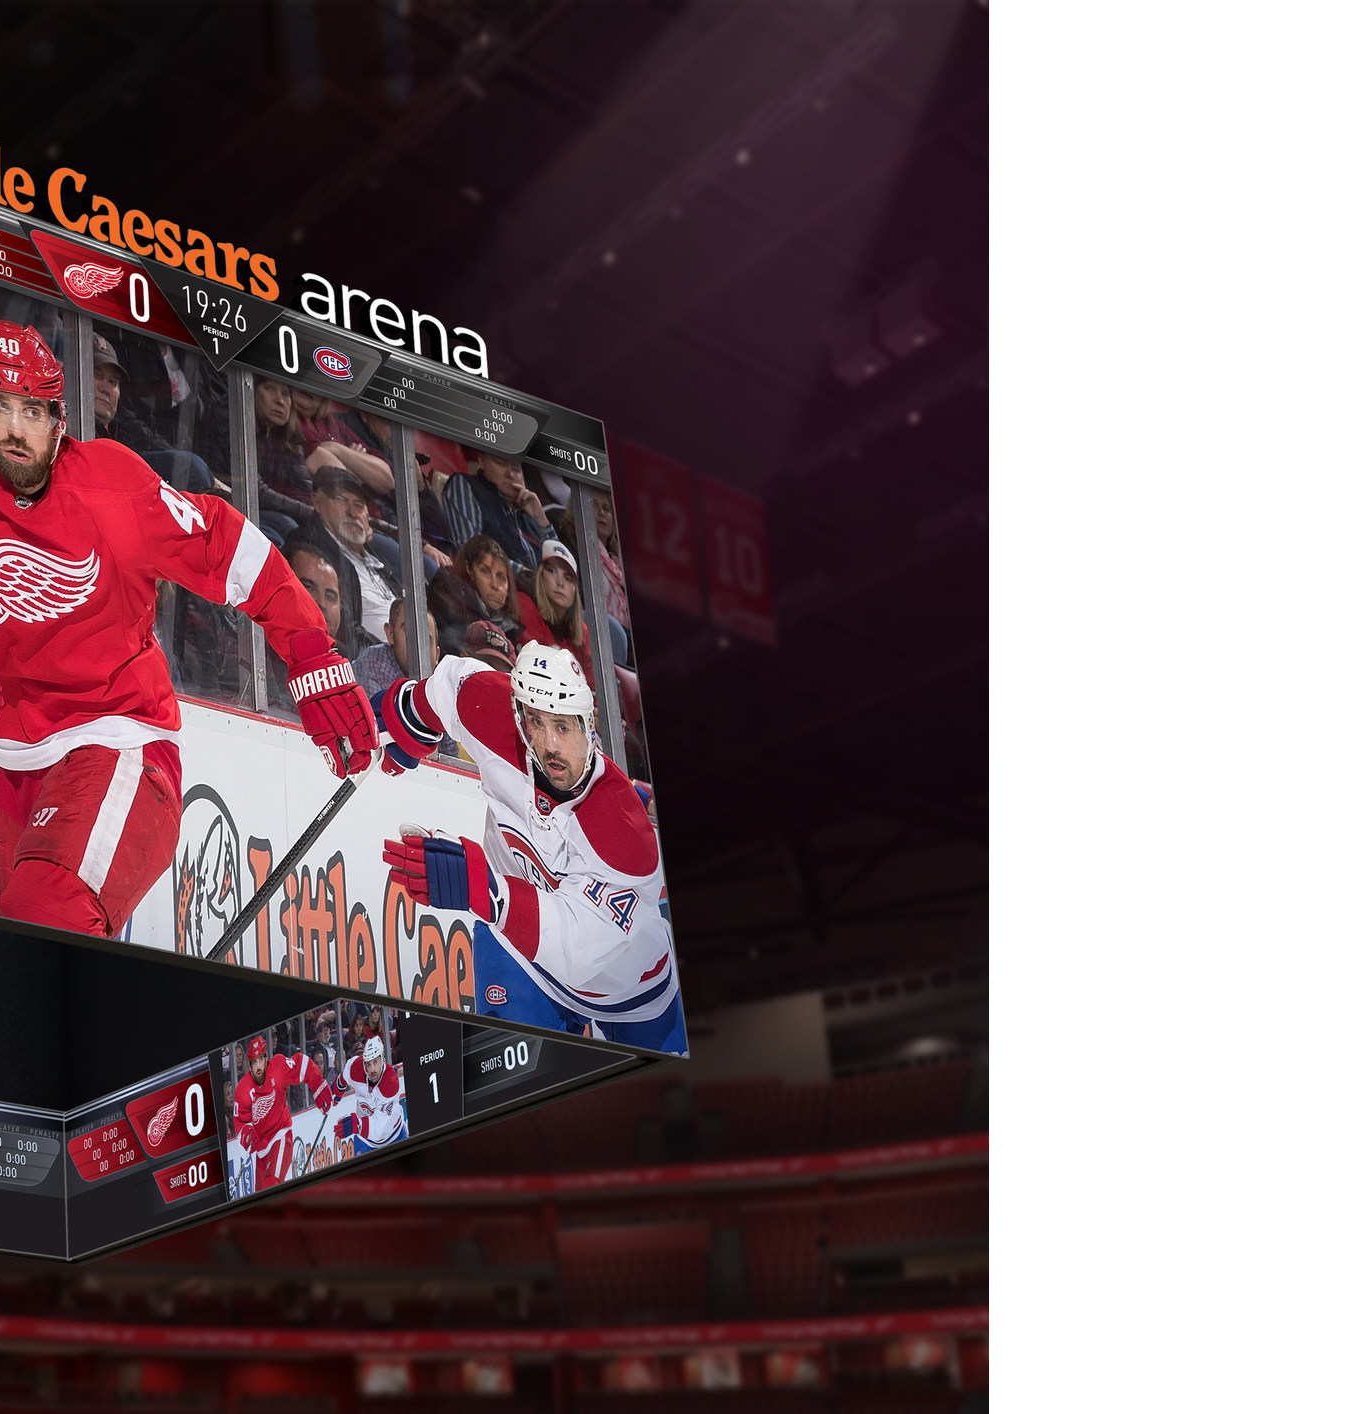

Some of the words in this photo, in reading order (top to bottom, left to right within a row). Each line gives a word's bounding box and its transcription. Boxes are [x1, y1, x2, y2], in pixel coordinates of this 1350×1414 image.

[48, 167, 280, 301] Caesars
[301, 272, 489, 378] arena
[129, 272, 150, 323] 0
[182, 285, 247, 333] 19:26
[202, 324, 230, 341] PERIOD
[212, 337, 220, 355] 1
[278, 325, 300, 374] 0
[393, 387, 406, 399] 00
[483, 418, 505, 434] 0:00
[402, 377, 415, 390] 00
[491, 409, 513, 425] 0:00
[383, 396, 397, 409] 00
[475, 428, 497, 443] 0:00
[550, 445, 572, 462] SHOTS
[574, 450, 599, 475] 00
[533, 657, 547, 670] 14
[288, 661, 357, 704] WARRIO
[528, 686, 553, 697] CCM
[583, 876, 640, 935] 14
[420, 1048, 444, 1065] PERIOD
[480, 1055, 502, 1074] SHOTS
[503, 1041, 529, 1070] 00
[429, 1072, 439, 1103] 1
[185, 1083, 205, 1136] 0
[17, 1140, 38, 1152] 0:00
[30, 1128, 60, 1139] PENALTY
[83, 1137, 92, 1149] 00
[103, 1127, 118, 1142] 0:00
[6, 1152, 26, 1165] 0:00
[92, 1148, 101, 1160] 00
[112, 1138, 127, 1153] 0:00
[100, 1160, 109, 1172] 00
[119, 1150, 135, 1165] 0:00
[169, 1173, 186, 1189] SHOTS
[188, 1161, 208, 1187] 00
